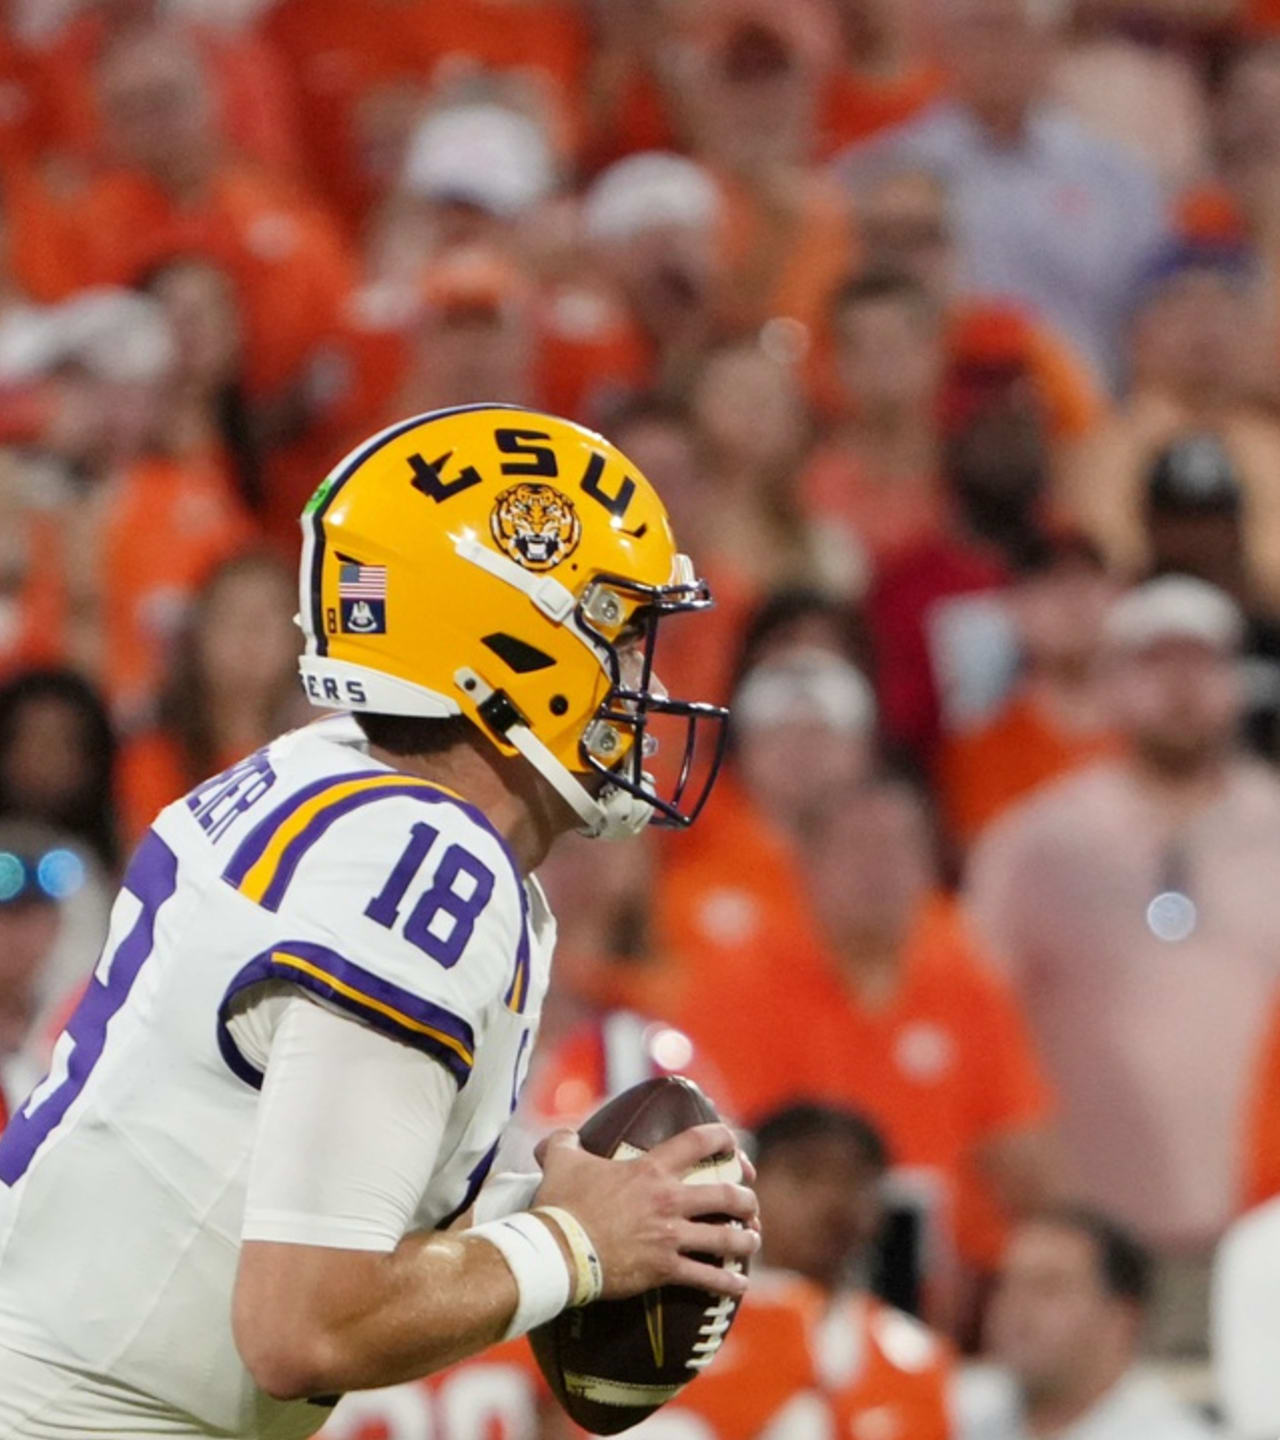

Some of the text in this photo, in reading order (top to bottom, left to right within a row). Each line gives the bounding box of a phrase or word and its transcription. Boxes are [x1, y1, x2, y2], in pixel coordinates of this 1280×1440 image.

[407, 429, 636, 519] LSU
[306, 674, 366, 703] ERS
[363, 822, 495, 969] 18
